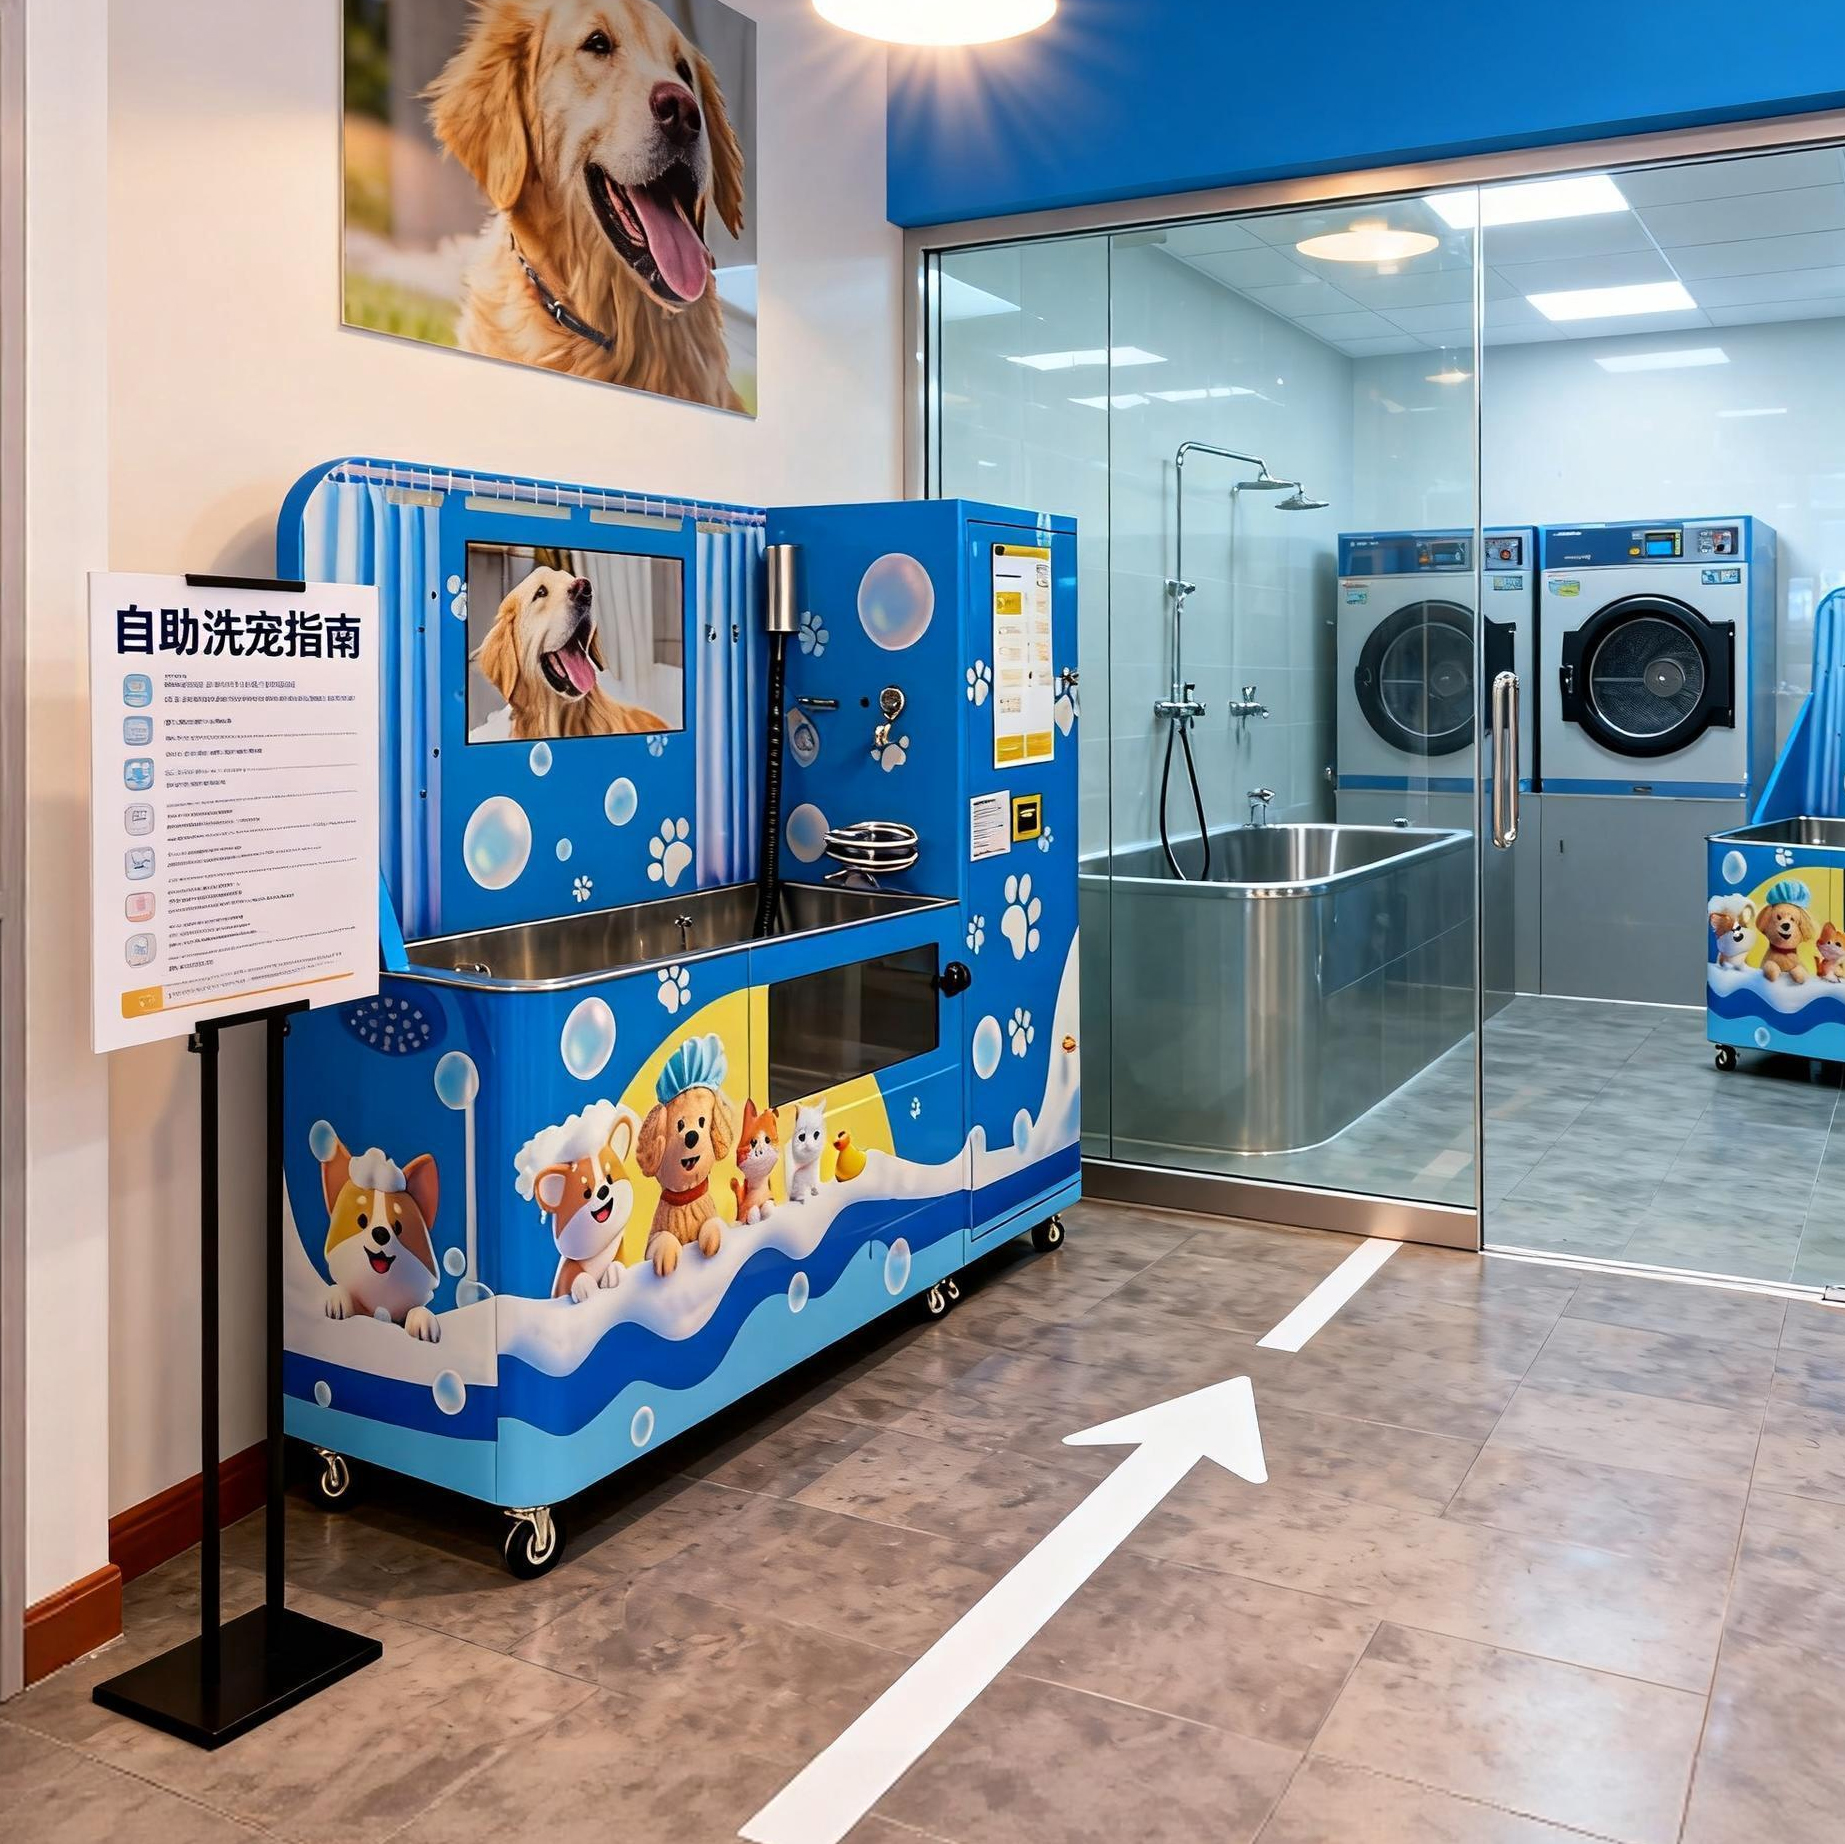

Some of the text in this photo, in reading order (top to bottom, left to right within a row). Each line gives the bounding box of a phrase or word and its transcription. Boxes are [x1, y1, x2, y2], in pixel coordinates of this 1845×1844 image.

[117, 604, 361, 659] 自助洗宠指南
